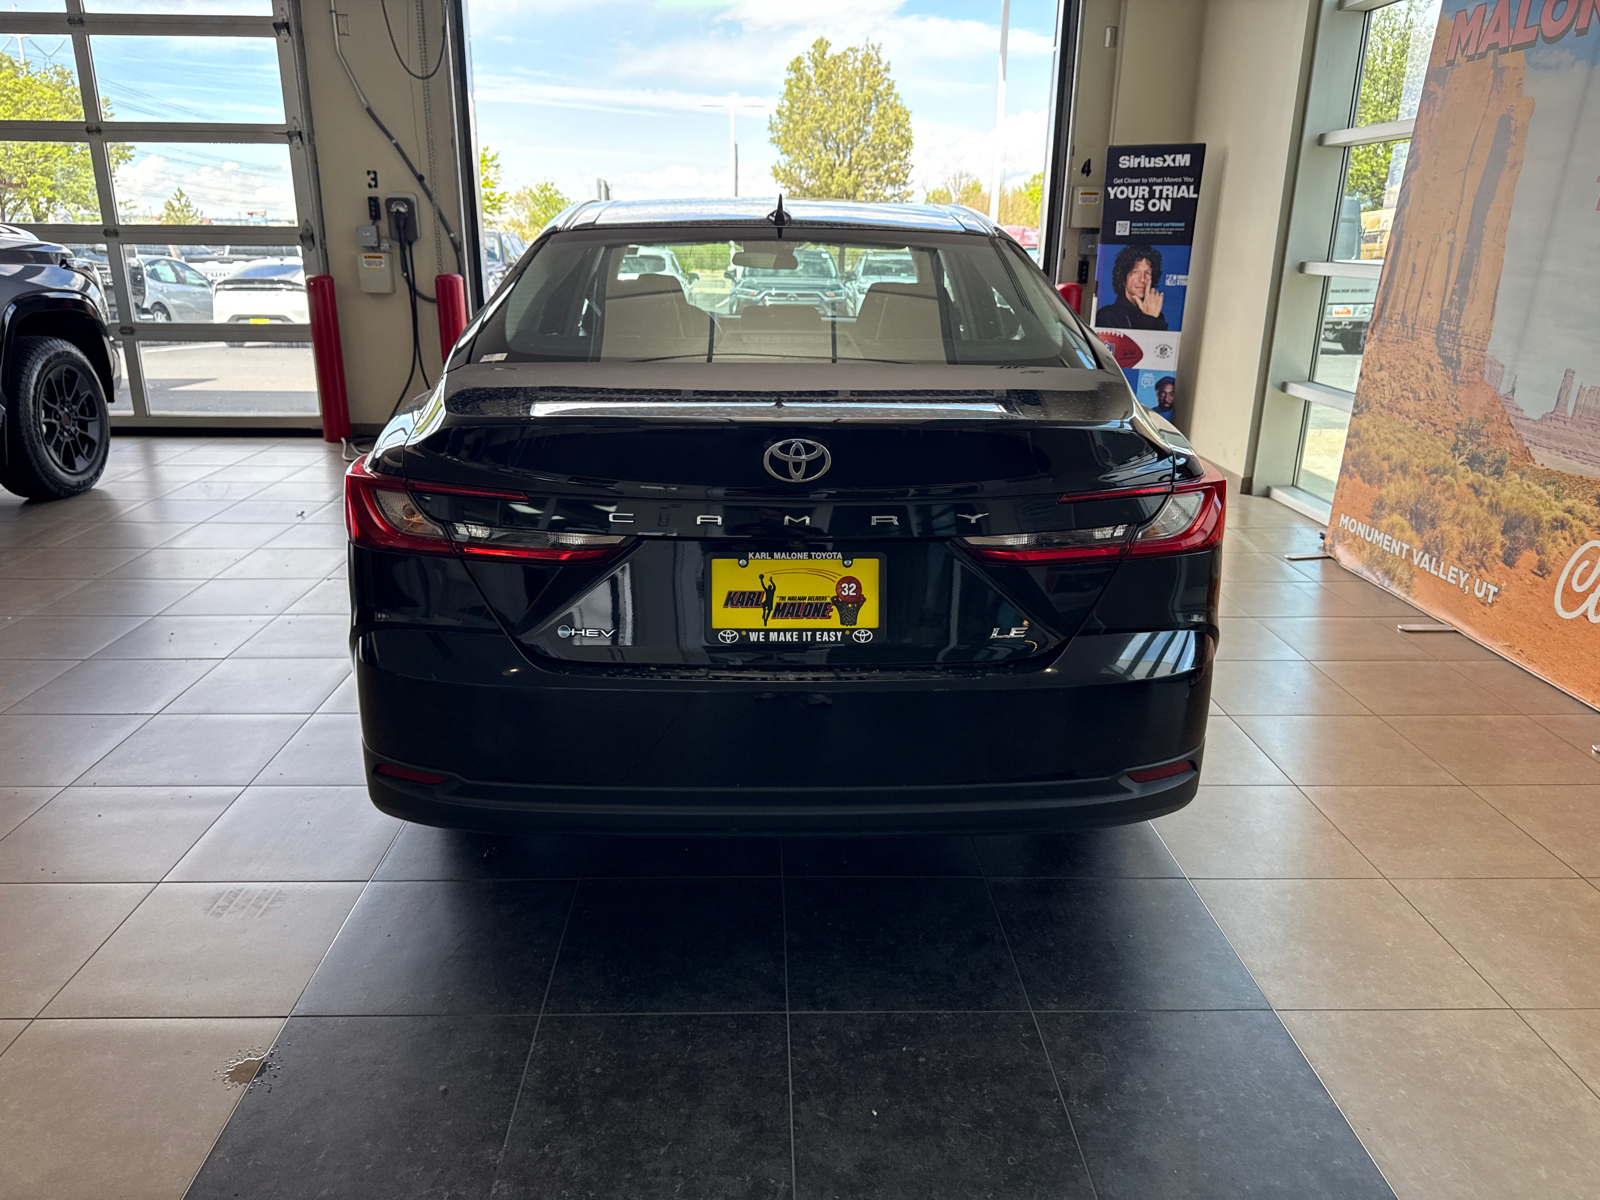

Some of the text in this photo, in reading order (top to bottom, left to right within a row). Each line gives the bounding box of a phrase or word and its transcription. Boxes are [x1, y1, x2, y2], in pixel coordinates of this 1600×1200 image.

[1080, 158, 1092, 177] 4
[1118, 153, 1191, 169] SiriusXM
[366, 170, 379, 189] 3
[1107, 185, 1198, 199] YOUR TRIAL
[1129, 199, 1172, 212] IS ON
[608, 512, 990, 526] CAMRY
[748, 552, 843, 560] KARL MALONE TOYOTA
[1339, 512, 1499, 604] MONUMENT VALLEY, UT
[840, 582, 857, 596] 32
[723, 590, 765, 608] KARL
[771, 601, 834, 620] MALONE
[571, 628, 617, 638] HEV
[749, 631, 843, 642] WE MAKE IT EASY
[989, 627, 1029, 639] LE
